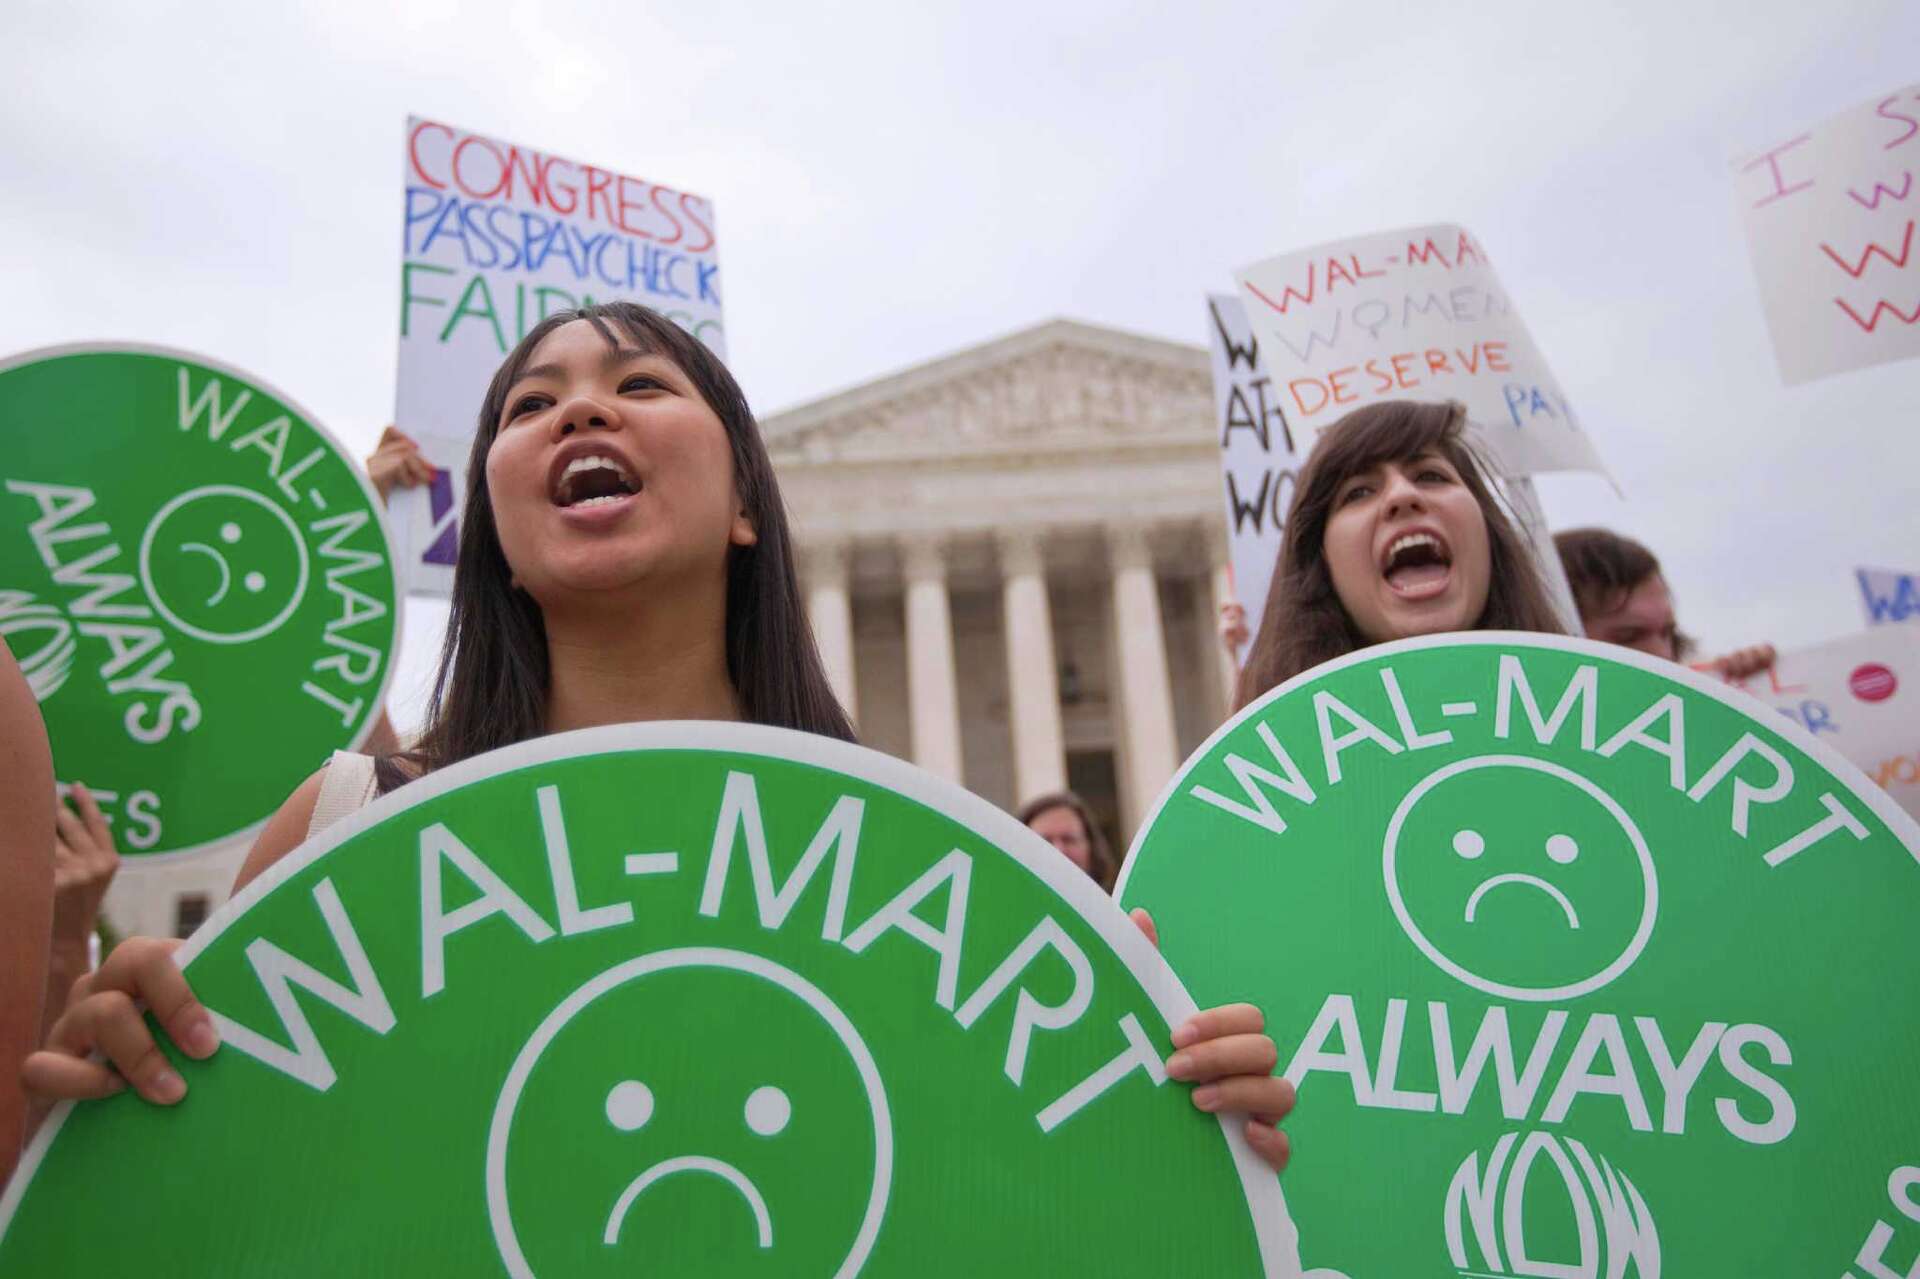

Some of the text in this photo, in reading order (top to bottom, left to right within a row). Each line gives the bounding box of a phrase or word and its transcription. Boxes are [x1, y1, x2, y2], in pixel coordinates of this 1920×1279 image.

[407, 121, 716, 253] CONGRESS
[1288, 341, 1512, 416] DESERVE
[5, 477, 202, 744] ALWAYS
[177, 365, 388, 729] WAL-MART
[1189, 653, 1871, 868] WAL-MART
[211, 770, 1169, 1133] WAL-MART
[1282, 994, 1797, 1145] ALWAYS
